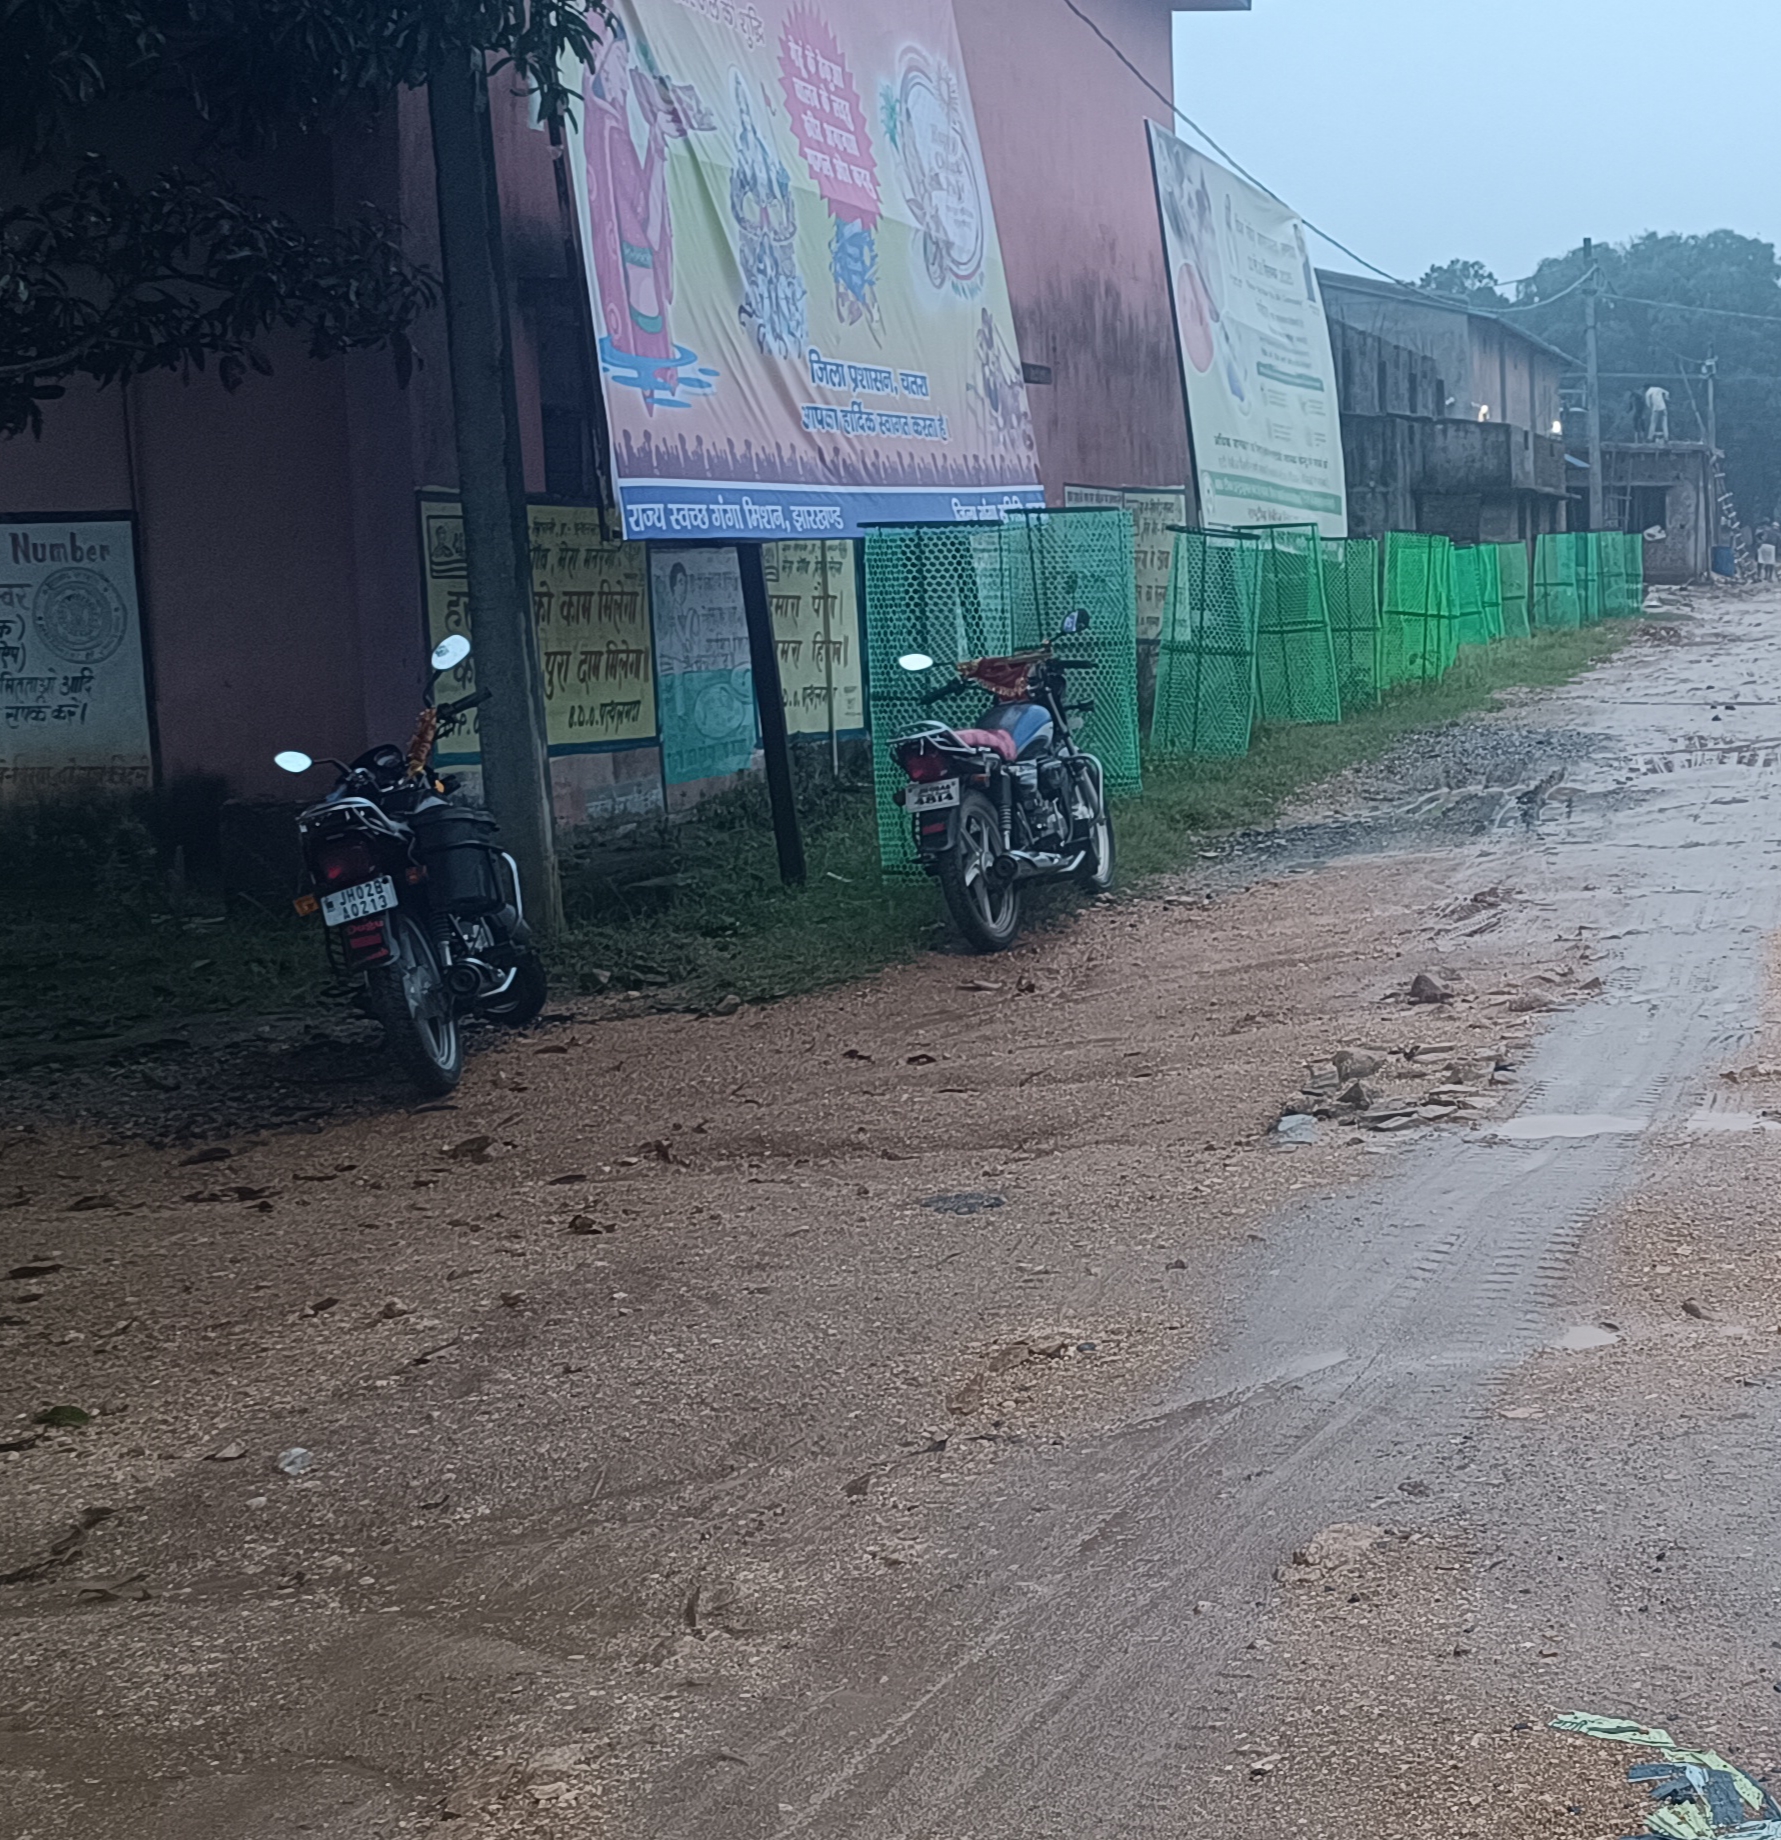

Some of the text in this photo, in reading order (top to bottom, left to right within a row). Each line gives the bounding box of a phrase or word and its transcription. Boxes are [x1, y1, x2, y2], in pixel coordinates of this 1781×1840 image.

[808, 348, 846, 388] जिला
[899, 372, 930, 397] चतरा
[801, 405, 839, 431] आपका
[840, 400, 877, 435] हार्दिक
[876, 412, 912, 436] स्वागत
[911, 415, 939, 438] करता
[626, 503, 667, 531] राज्य
[667, 503, 710, 531] स्वच्छ
[709, 494, 745, 530] गंगा
[790, 505, 844, 532] झारखण्ड
[8, 530, 111, 565] Number
[560, 590, 595, 627] काम
[577, 650, 604, 695] दाम
[339, 880, 385, 907] JH02B
[342, 894, 389, 921] A0213
